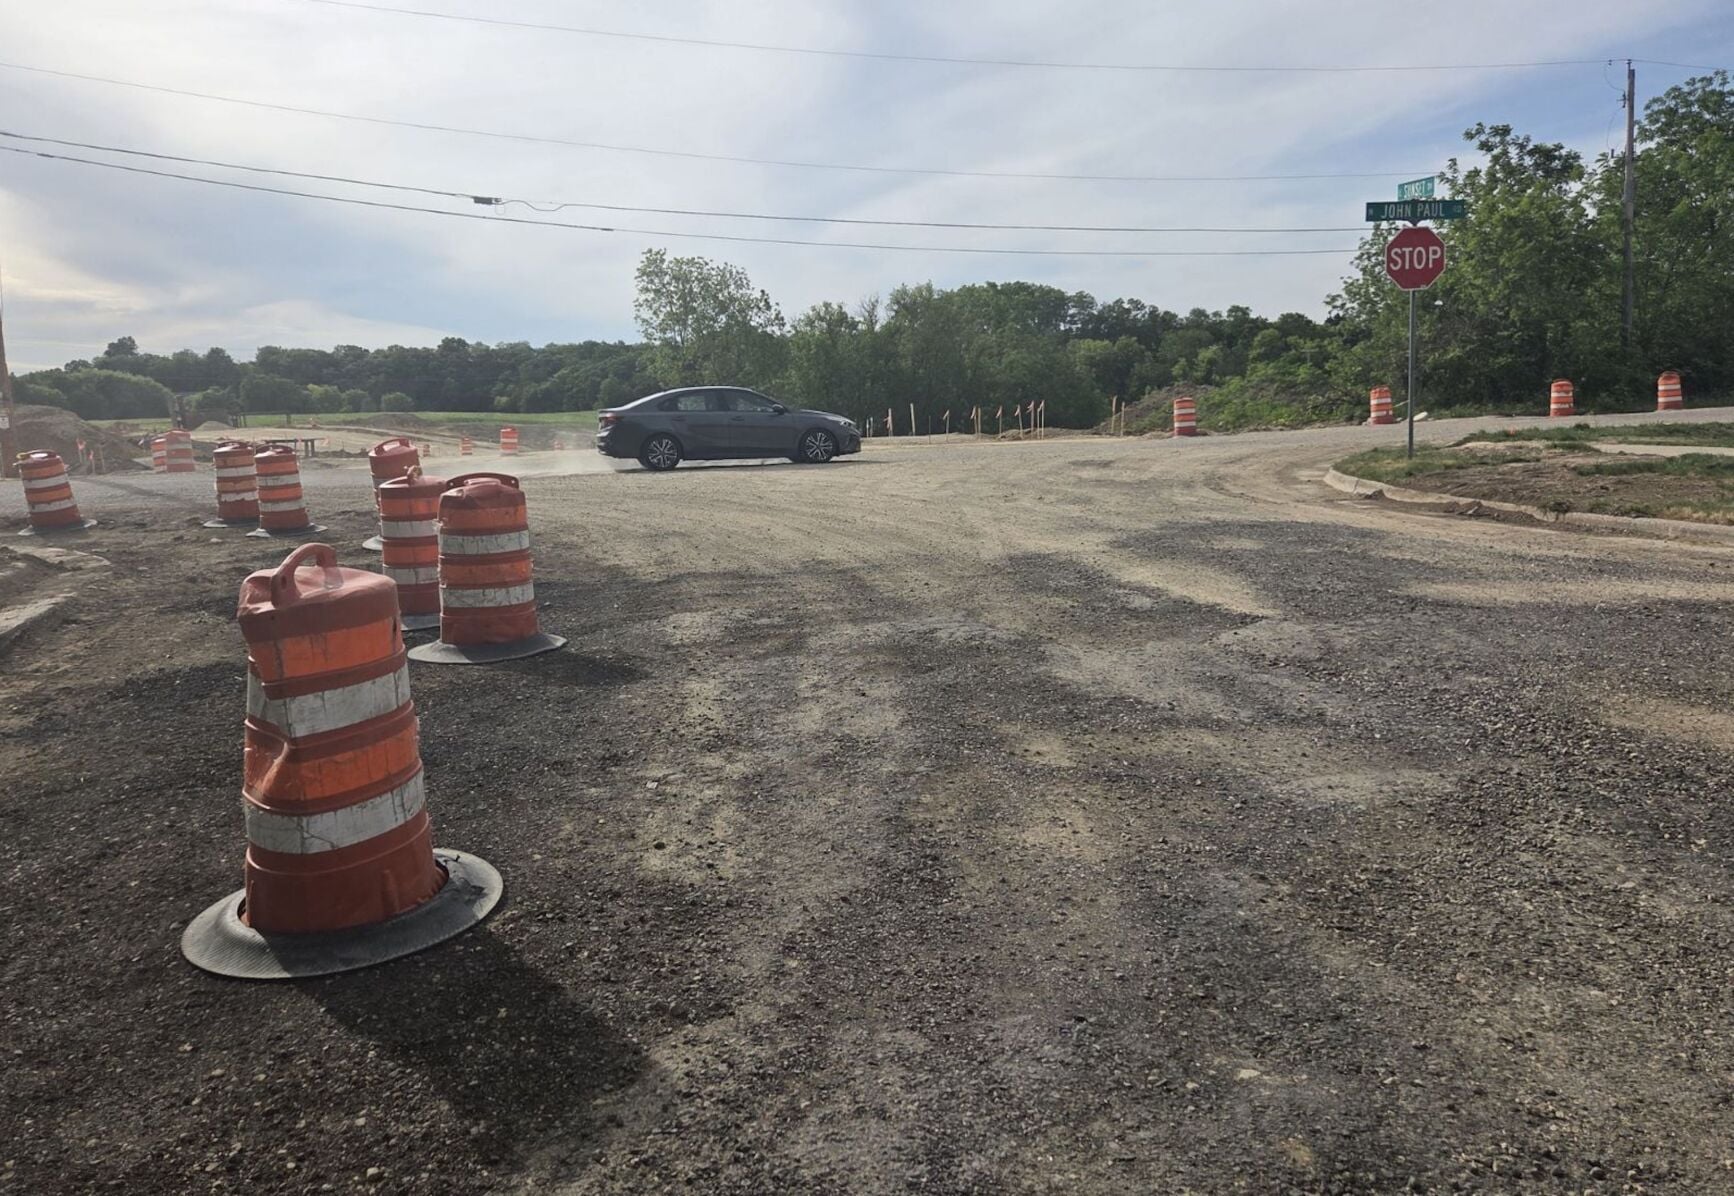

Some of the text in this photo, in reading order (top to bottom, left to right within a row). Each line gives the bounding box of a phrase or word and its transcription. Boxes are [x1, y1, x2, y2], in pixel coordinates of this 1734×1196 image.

[1381, 202, 1411, 218] JOHN
[1416, 202, 1445, 217] PAUL
[1390, 246, 1441, 270] STOP
